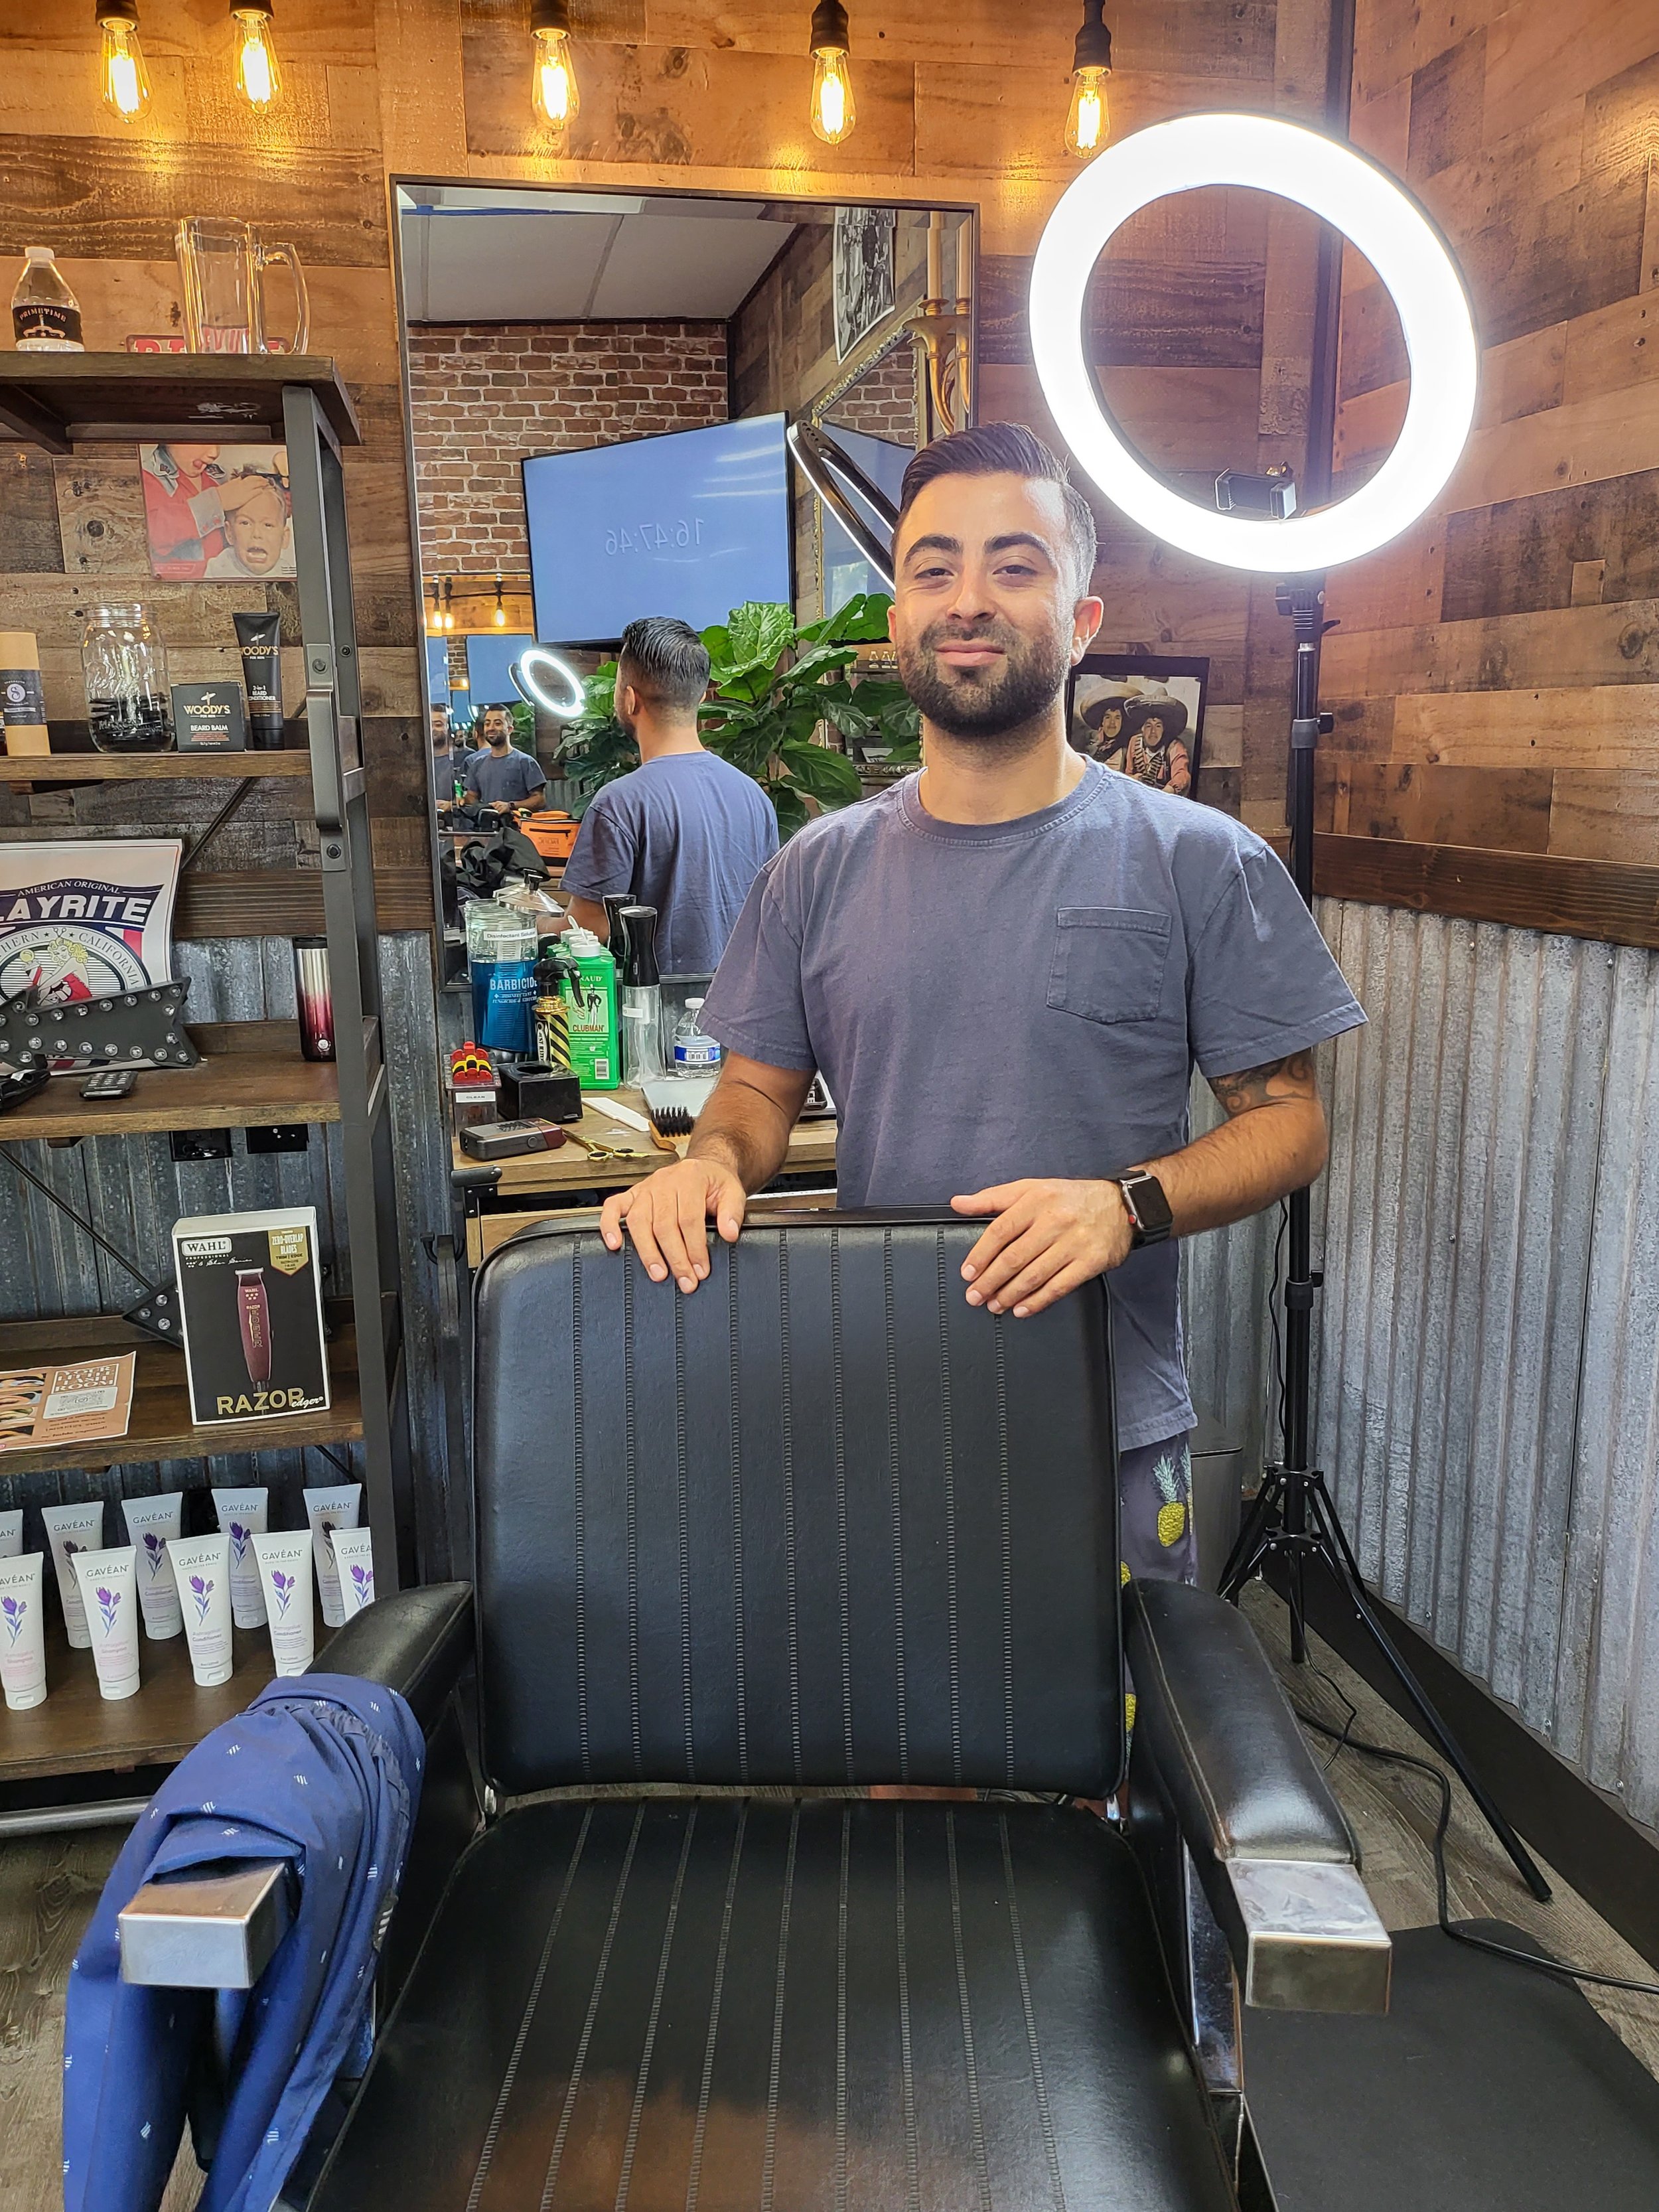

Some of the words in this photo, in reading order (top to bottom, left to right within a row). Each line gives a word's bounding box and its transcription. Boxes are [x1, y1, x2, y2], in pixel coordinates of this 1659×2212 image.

[19, 307, 67, 323] PRIMETIME
[241, 646, 279, 656] OODY'S
[183, 705, 231, 715] WOODY'S
[17, 880, 72, 897] AMERICAN
[74, 880, 121, 895] ORIGINAL
[0, 895, 152, 923] AYRITE
[0, 931, 39, 954] HERN
[186, 1240, 226, 1252] WAHL
[55, 1380, 113, 1392] ROOM
[216, 1387, 305, 1415] RAZOR
[291, 1396, 320, 1409] edger
[222, 1503, 257, 1512] GAVÉAN
[313, 1502, 350, 1512] GAVÉAN
[133, 1511, 172, 1524] GAVÉAN
[54, 1520, 93, 1532] GAVÉAN
[262, 1548, 301, 1560] GAVÉAN
[341, 1543, 372, 1556] GAVÉA
[179, 1552, 220, 1566] GAVÉAN
[86, 1564, 127, 1578] GAVÉAN
[0, 1574, 34, 1585] AVÉAN
